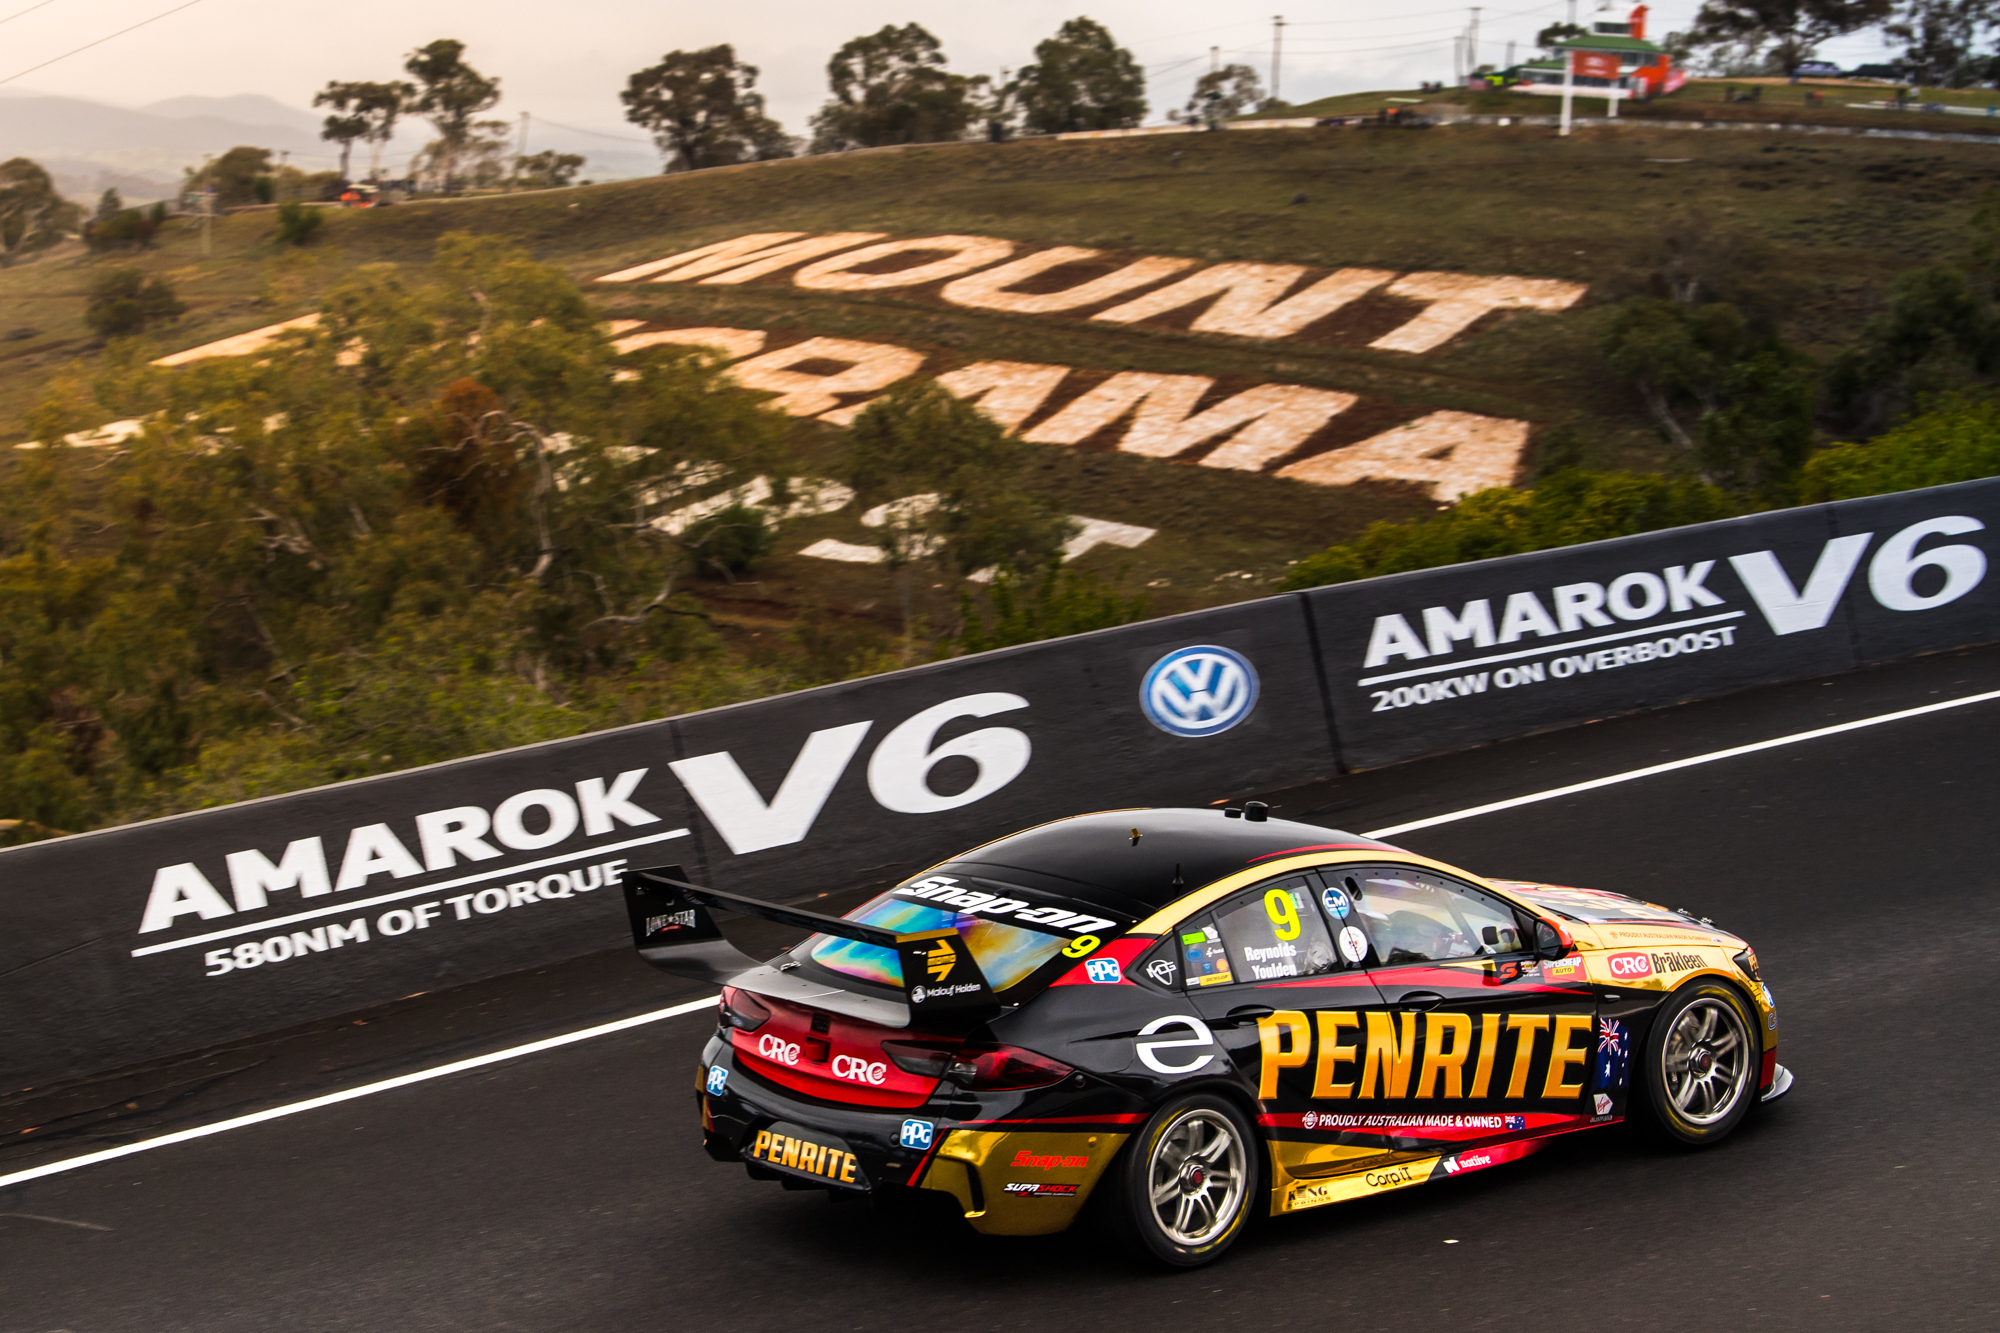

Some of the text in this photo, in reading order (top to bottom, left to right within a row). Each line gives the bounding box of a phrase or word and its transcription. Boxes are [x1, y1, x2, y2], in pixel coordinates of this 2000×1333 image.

[596, 232, 1588, 354] MOUNT
[1363, 515, 1988, 669] AMAROK V6
[1370, 626, 1738, 712] 200KW ON OVERBOOST
[138, 692, 1032, 934] AMAROK V6
[892, 875, 1117, 934] Snap-on
[1325, 895, 1346, 908] CM
[205, 859, 629, 977] 580NM OF TORQUE
[1264, 888, 1301, 941] 9
[1061, 934, 1101, 958] 9
[1244, 943, 1297, 962] Reynolds
[1089, 960, 1119, 979] PPG
[1251, 963, 1298, 980] Youlden
[1543, 956, 1582, 970] SUPERCHEAP
[1610, 955, 1649, 975] CRC
[927, 983, 981, 998] Malouf Holden
[759, 1033, 801, 1066] CRC
[1256, 1010, 1593, 1100] PENRITE
[708, 1068, 726, 1091] PPG
[832, 1054, 887, 1085] CRC
[903, 1121, 931, 1145] PPG
[1319, 1114, 1365, 1127] PROUDLY
[1364, 1115, 1425, 1127] AUSTRALIAN
[1425, 1115, 1454, 1127] MADE
[1455, 1115, 1463, 1128] &
[1464, 1115, 1503, 1129] OWNED
[753, 1130, 857, 1183] PENRITE
[1010, 1150, 1089, 1170] Snap-on
